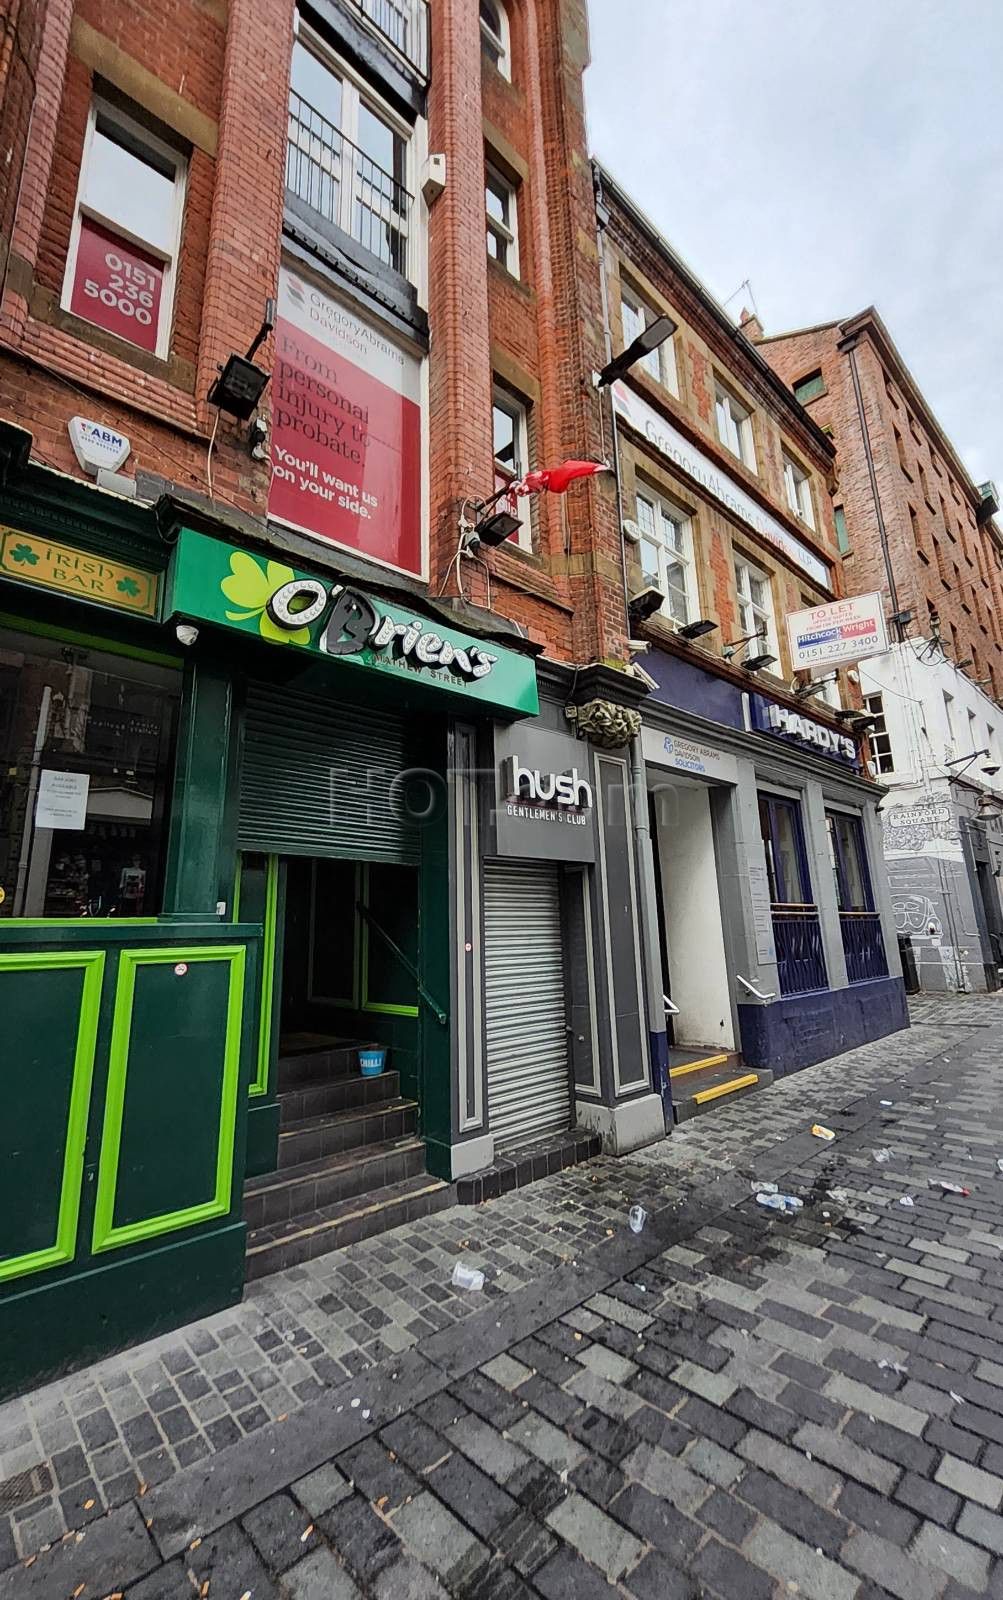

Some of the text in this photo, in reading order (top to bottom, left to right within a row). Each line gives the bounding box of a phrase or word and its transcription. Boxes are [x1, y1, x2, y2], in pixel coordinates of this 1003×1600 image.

[105, 253, 156, 291] 0151
[108, 274, 153, 308] 236
[83, 279, 152, 325] 5000
[281, 335, 338, 384] From
[279, 361, 369, 424] personal
[277, 381, 371, 449] injury to
[91, 428, 123, 448] ABM
[276, 406, 366, 468] probate.
[273, 465, 372, 519] on your side.
[274, 443, 379, 508] You'll want us
[52, 567, 105, 592] BAR
[265, 578, 499, 681] O'Brien's
[797, 625, 842, 643] Hitchcock
[841, 617, 876, 633] Wright
[809, 608, 827, 620] TO
[830, 602, 855, 615] LET
[799, 647, 823, 659] 0151
[828, 642, 848, 653] 227
[851, 634, 879, 648] 3400
[766, 703, 857, 760] HARDY'S
[511, 754, 594, 809] hush
[506, 804, 587, 826] GENTLEMEN'S CLUB
[892, 807, 946, 820] RAINFORD
[899, 814, 942, 826] SQUARE
